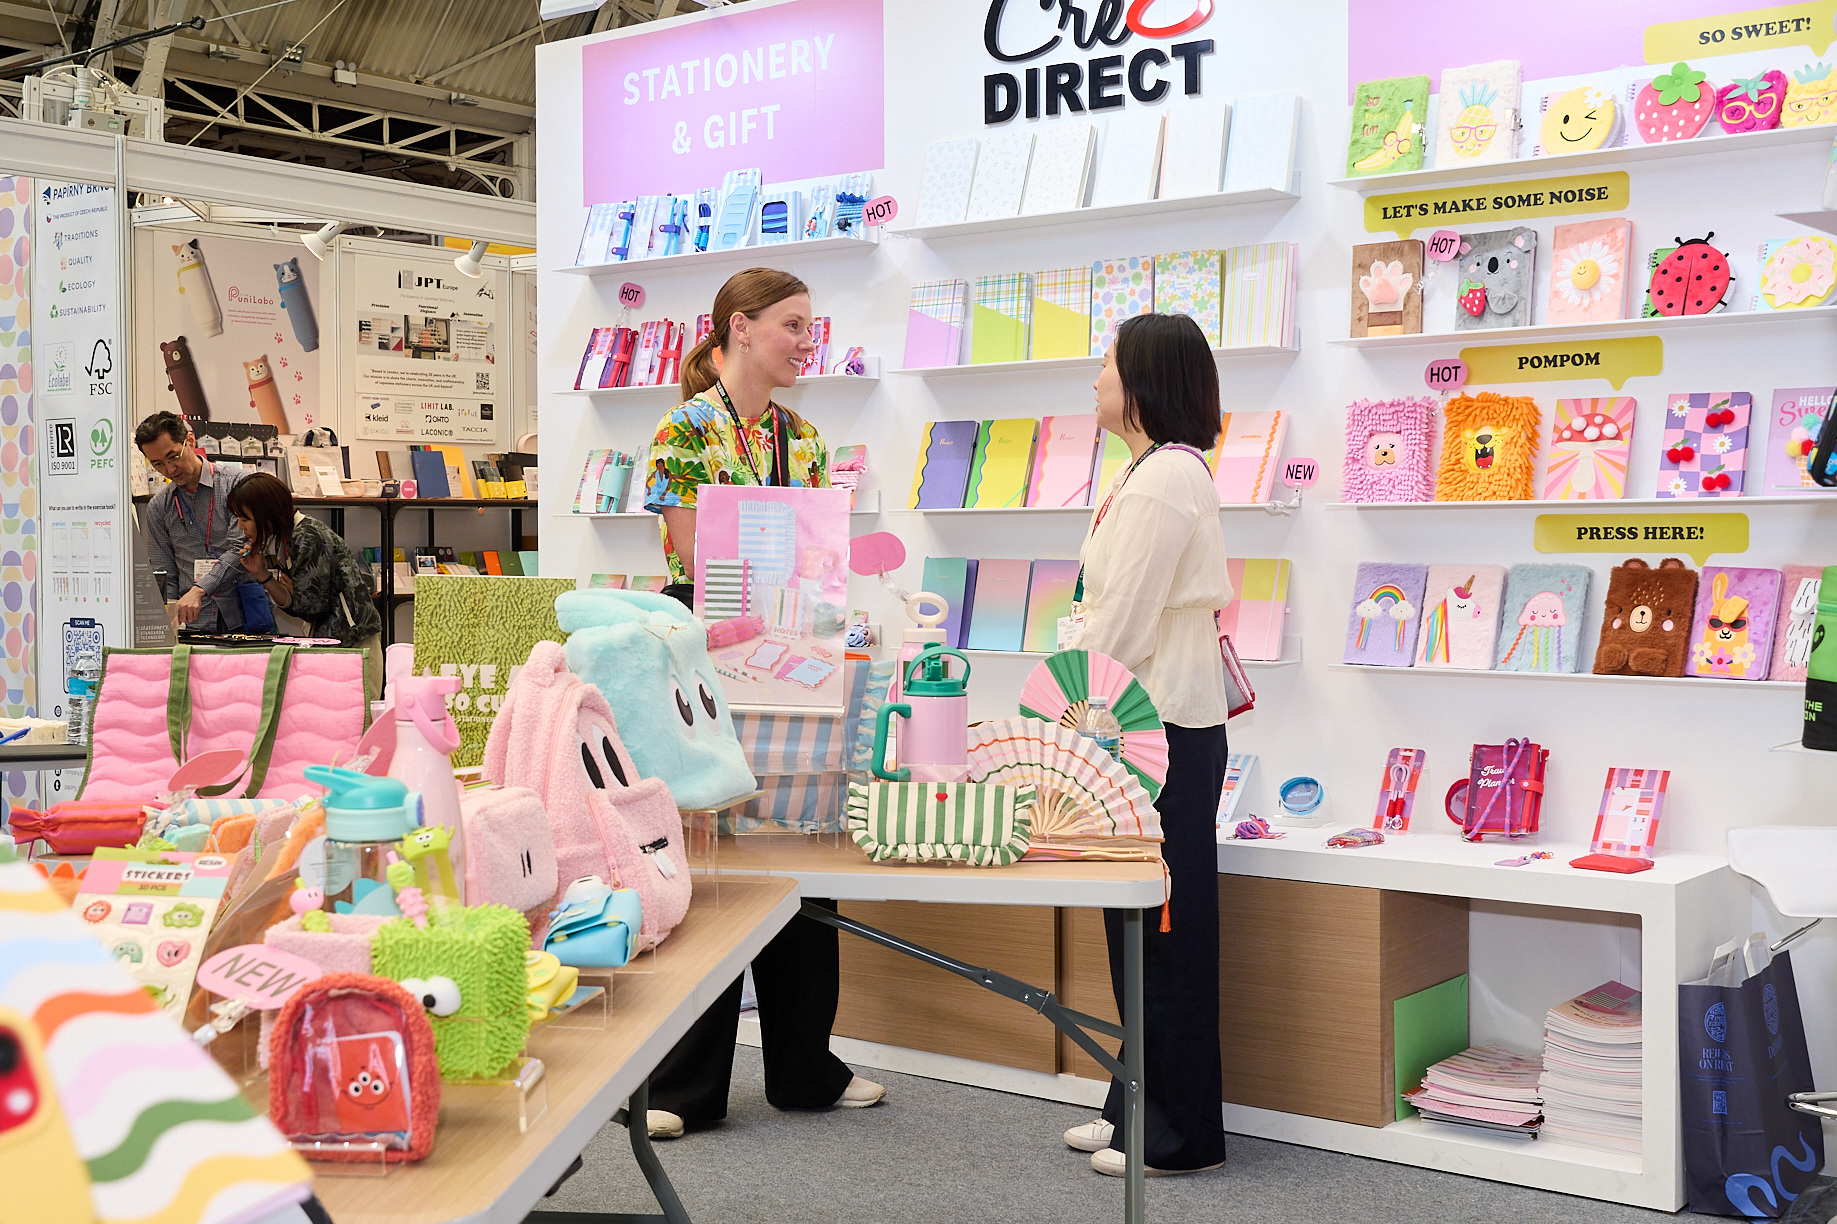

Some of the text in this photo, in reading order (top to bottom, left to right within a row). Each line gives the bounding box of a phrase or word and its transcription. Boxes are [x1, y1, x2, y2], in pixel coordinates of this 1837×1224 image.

[1698, 17, 1811, 45] SO SWEET!
[623, 33, 835, 106] STATIONERY
[984, 39, 1216, 125] DIRECT
[672, 104, 781, 155] & GIFT
[1362, 124, 1379, 137] fun
[865, 200, 893, 222] HOT
[1381, 186, 1609, 221] LET'S MAKE SOME NOISE
[64, 229, 99, 242] TRADITIONS
[1430, 237, 1456, 255] HOT
[68, 255, 93, 266] QUALITY
[68, 280, 96, 291] ECOLOGY
[414, 276, 443, 289] JPT
[228, 286, 274, 305] PuniLabo
[621, 287, 641, 303] HOT
[59, 304, 107, 317] SUSTAINABILITY
[1517, 352, 1601, 370] POMPOM
[48, 373, 71, 388] Ecolabel
[1430, 365, 1461, 383] HOT
[89, 382, 113, 396] FSC
[420, 402, 439, 410] LIHIT
[440, 403, 454, 411] LAB.
[372, 414, 389, 422] kleid
[51, 461, 75, 470] ISO 9001
[90, 458, 114, 469] PEFC
[1285, 464, 1315, 481] NEW
[1576, 526, 1705, 541] PRESS HERE!
[774, 627, 798, 636] NOTES
[476, 694, 506, 713] CU
[126, 869, 191, 881] STICKERS
[211, 952, 306, 998] NEW
[1699, 1059, 1713, 1070] ON
